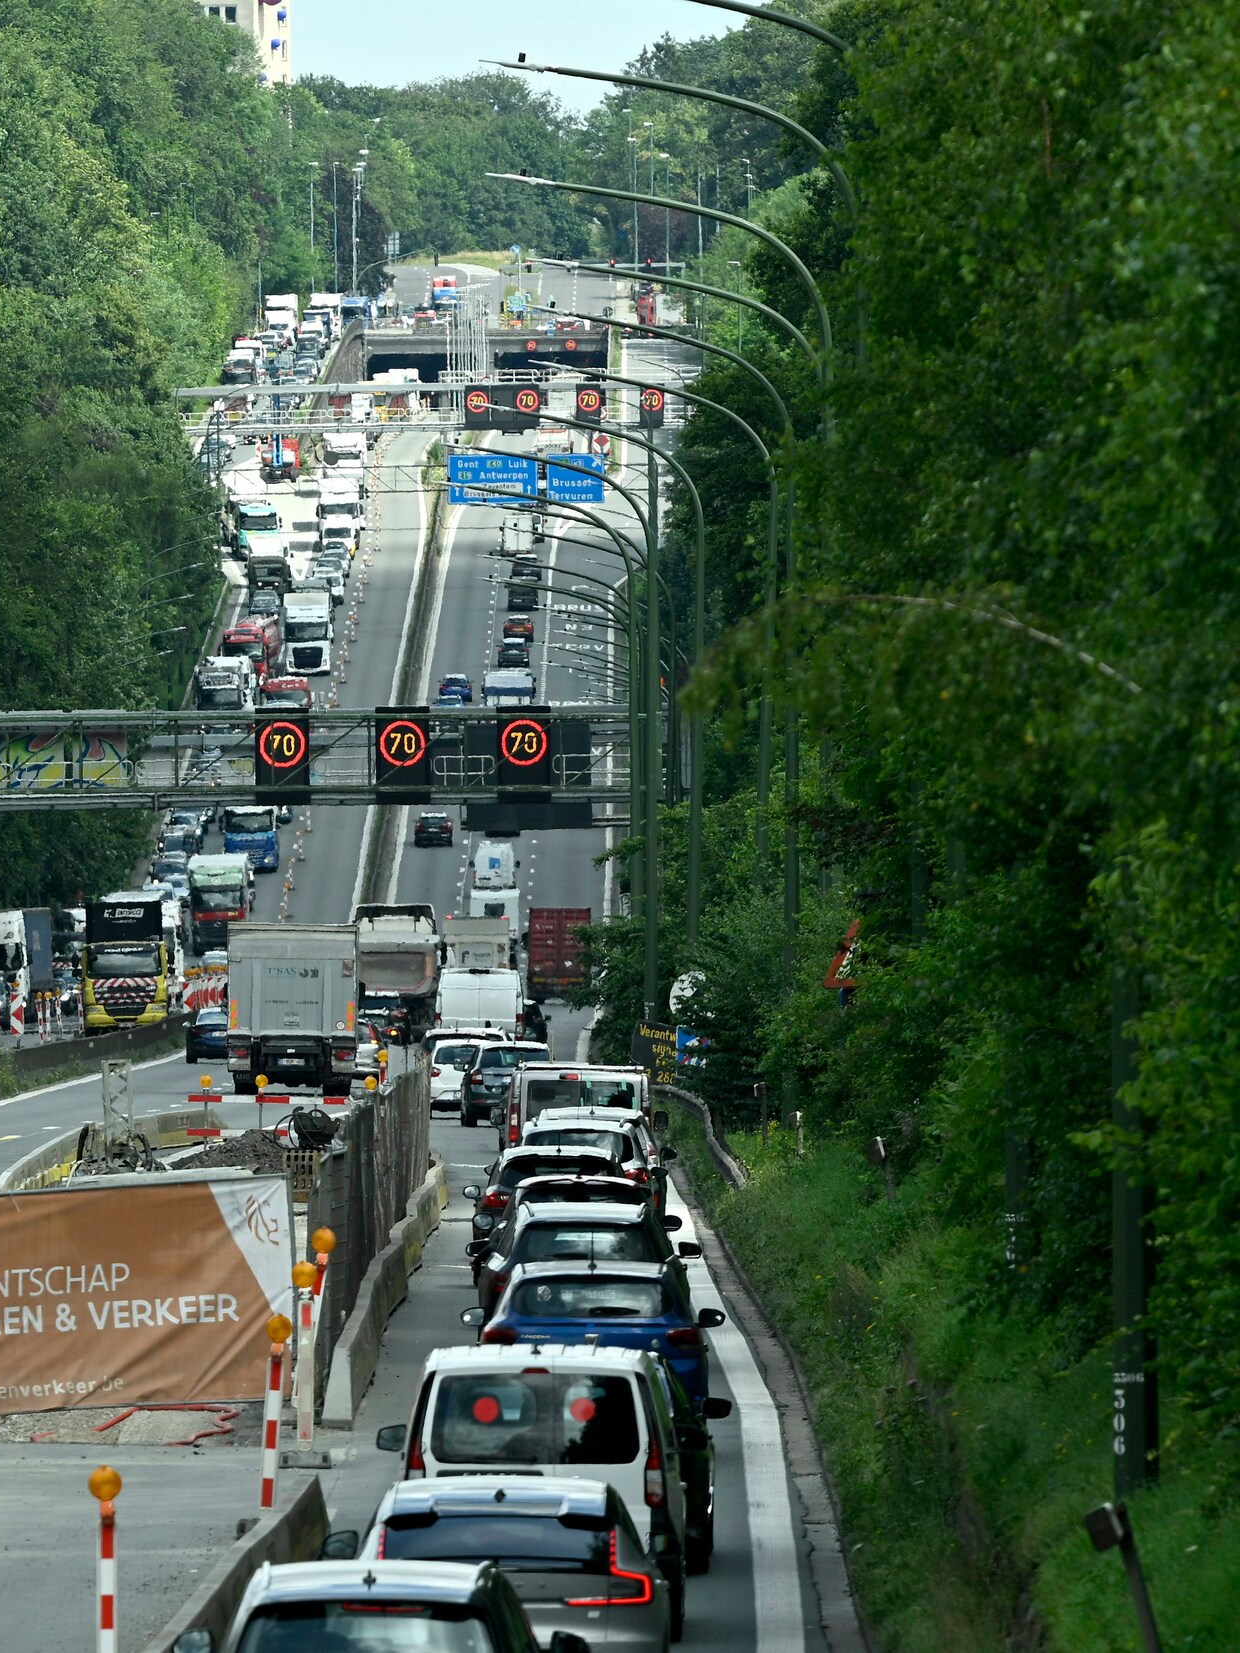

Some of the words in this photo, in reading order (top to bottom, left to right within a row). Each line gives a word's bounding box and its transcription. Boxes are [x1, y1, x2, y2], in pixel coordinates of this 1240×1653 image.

[521, 395, 534, 406] 70
[582, 395, 595, 406] 70
[457, 460, 479, 469] Gent
[508, 460, 528, 469] Luik
[479, 471, 528, 480] Antwerpen
[549, 491, 593, 500] Tervuren
[272, 735, 295, 757] 70
[389, 732, 416, 755] 70
[510, 731, 538, 754] 70
[54, 1302, 77, 1333] &
[87, 1293, 241, 1332] VERKEER
